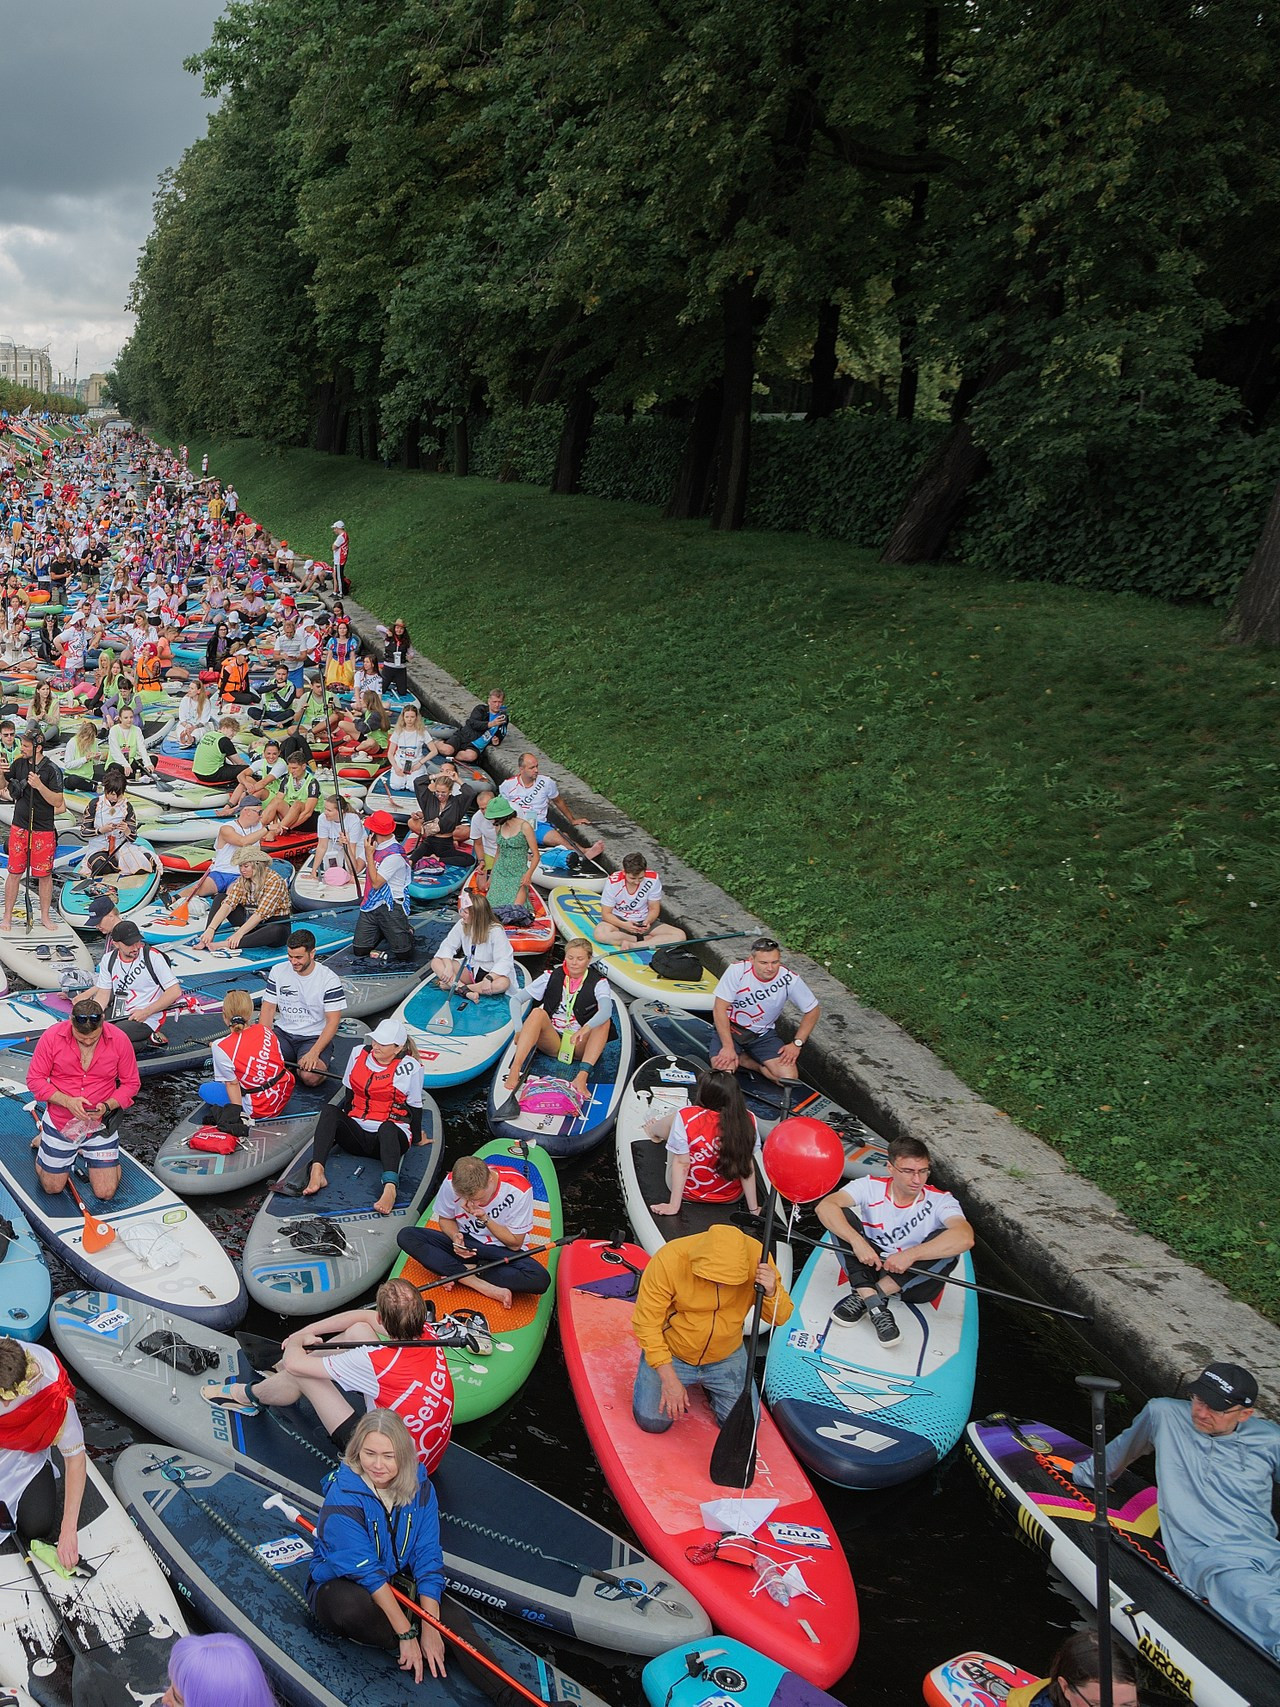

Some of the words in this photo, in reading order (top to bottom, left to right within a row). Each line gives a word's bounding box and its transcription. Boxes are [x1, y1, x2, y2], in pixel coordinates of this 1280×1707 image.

[518, 778, 546, 807] tlGroup
[252, 1024, 274, 1084] SetlGroup
[462, 1193, 516, 1235] tlGoup
[875, 1199, 933, 1248] tlGroup
[97, 1314, 124, 1329] 01296
[402, 1344, 448, 1433] SetlGro
[262, 1541, 305, 1559] 05642
[777, 1528, 821, 1540] 07177
[1138, 1635, 1194, 1700] AURORA
